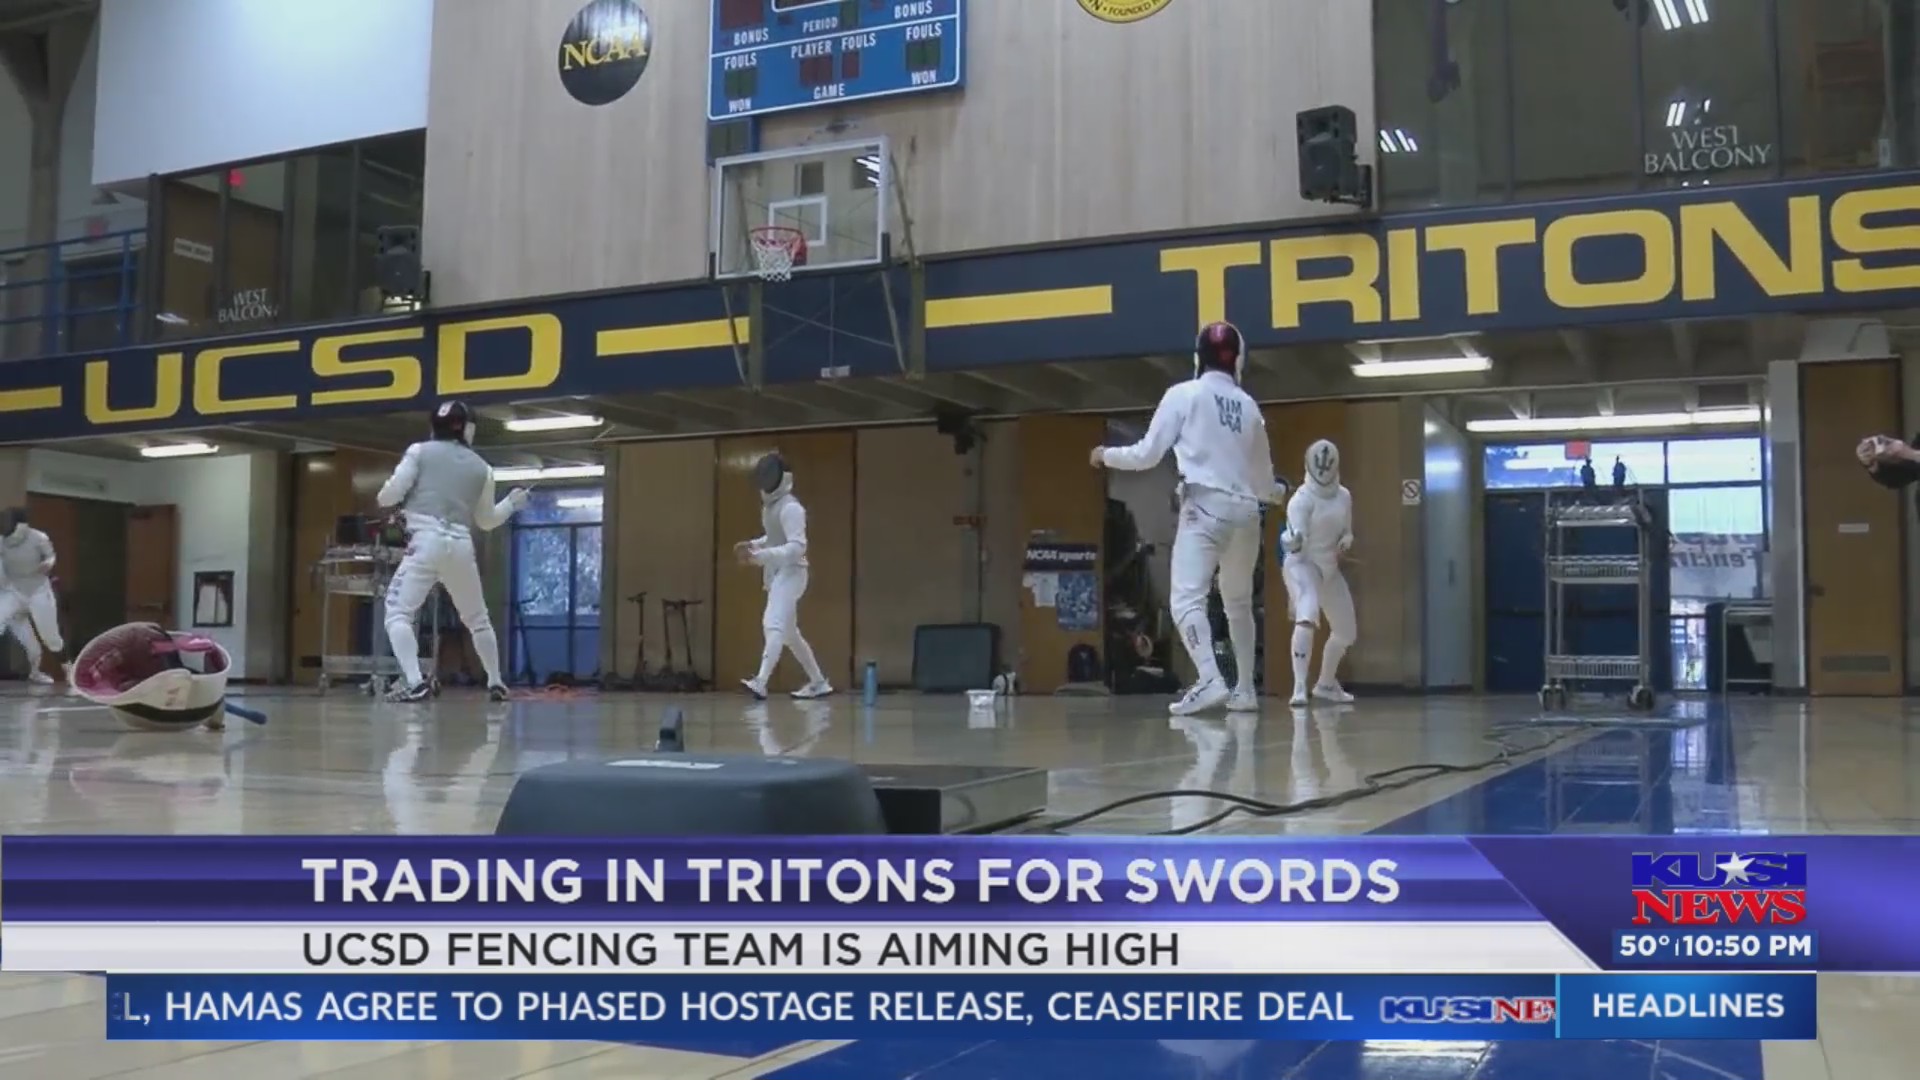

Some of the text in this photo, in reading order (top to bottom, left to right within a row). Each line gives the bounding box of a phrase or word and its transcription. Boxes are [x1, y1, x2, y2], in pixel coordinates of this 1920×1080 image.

[894, 0, 933, 19] BONUS
[802, 17, 838, 33] PERIOD
[906, 23, 942, 41] FOULS
[733, 28, 769, 46] BONUS
[791, 33, 877, 59] PLAYER FOULS
[563, 34, 647, 70] NCAA
[724, 53, 757, 70] FOULS
[911, 70, 937, 85] WON
[813, 84, 846, 100] GAME
[728, 98, 752, 113] WON
[1671, 125, 1738, 150] WEST
[1644, 144, 1771, 174] BALCONY
[85, 185, 1920, 424] UCSD TRITONS
[233, 288, 267, 305] WEST
[1214, 394, 1242, 415] KIM
[1026, 550, 1057, 560] NCAA
